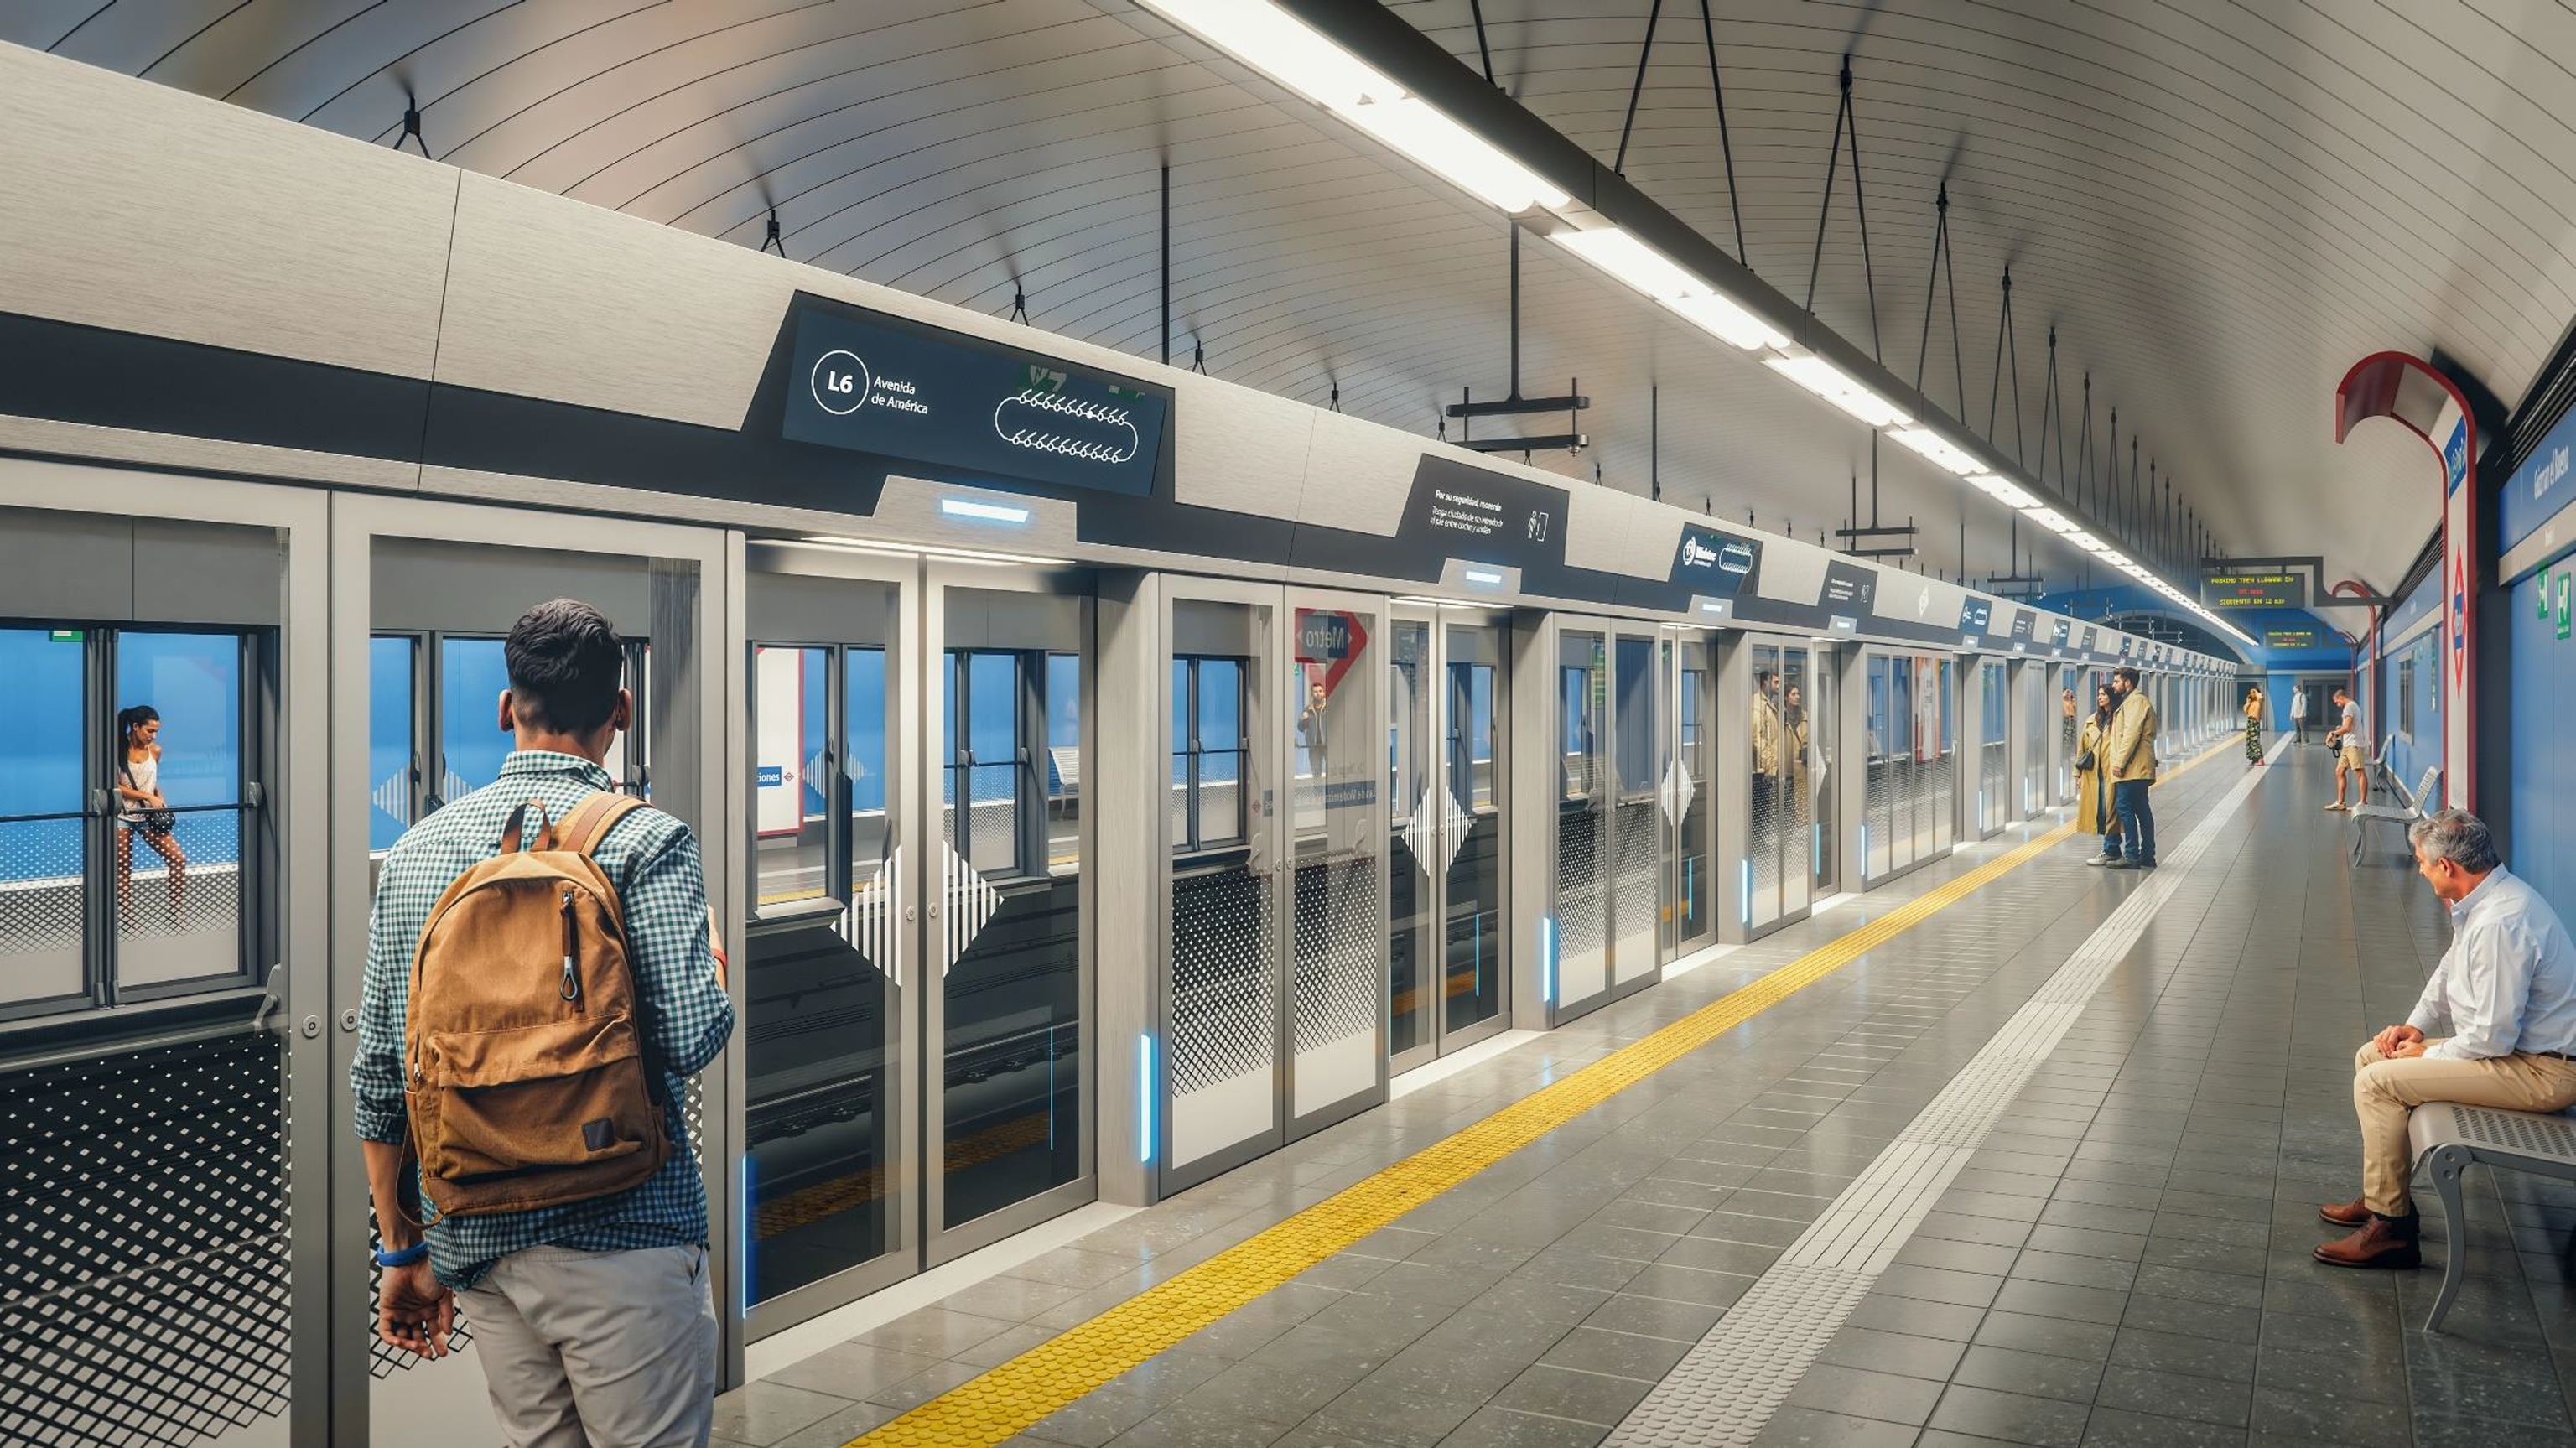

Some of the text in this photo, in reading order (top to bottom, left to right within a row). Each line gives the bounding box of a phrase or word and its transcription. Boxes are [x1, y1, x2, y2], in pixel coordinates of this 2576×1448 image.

[828, 370, 853, 394] L6
[873, 376, 916, 395] Avenida
[870, 392, 928, 414] de América
